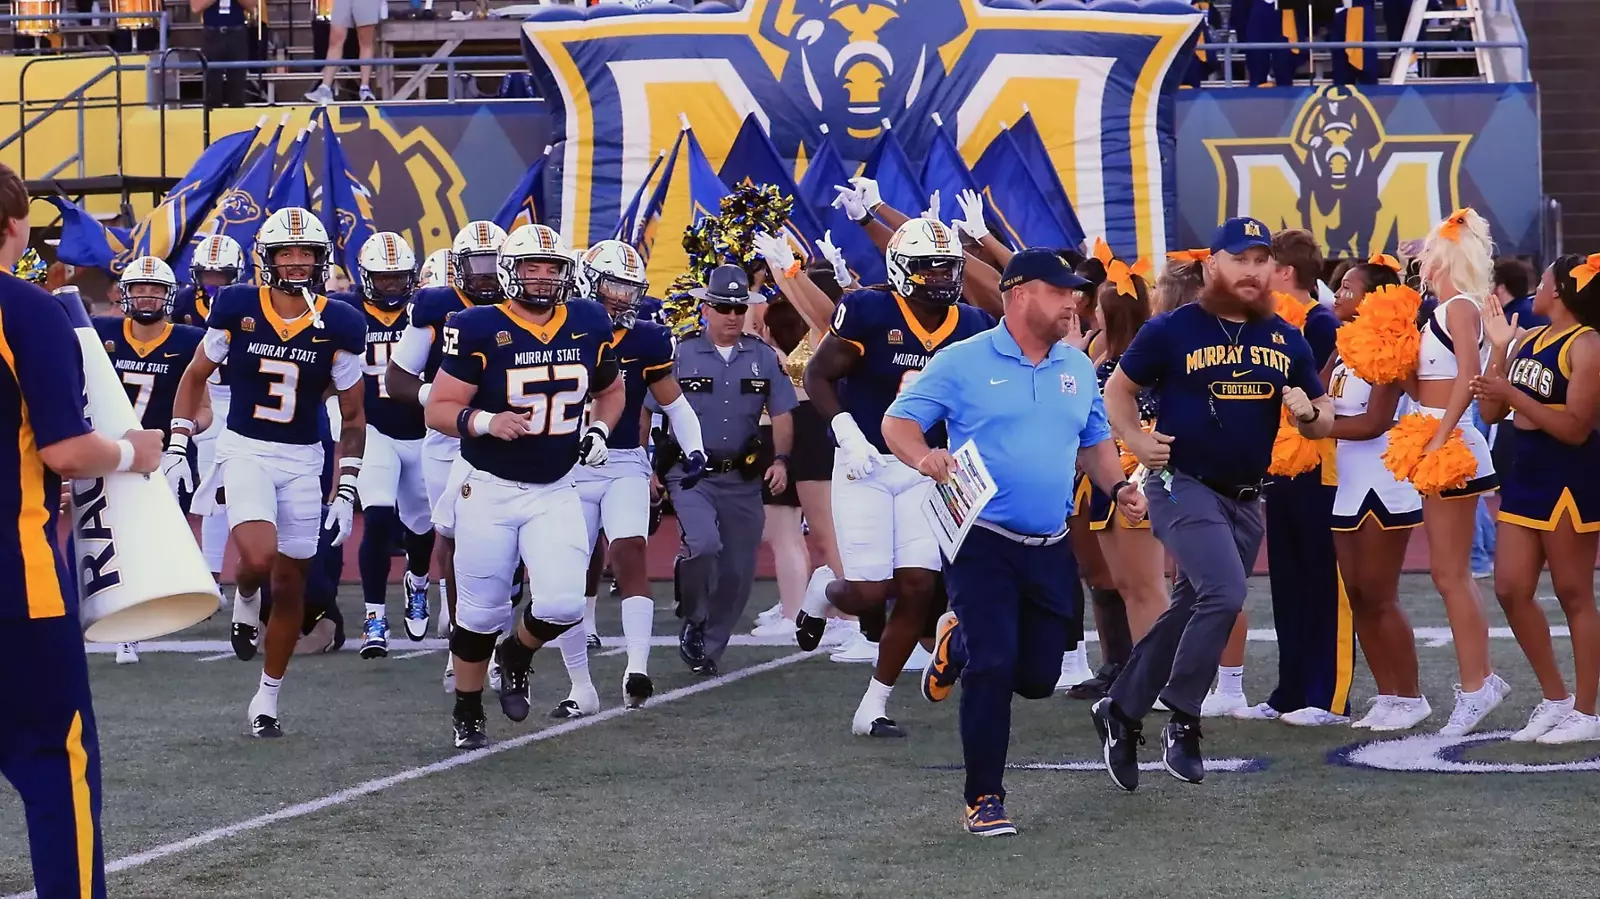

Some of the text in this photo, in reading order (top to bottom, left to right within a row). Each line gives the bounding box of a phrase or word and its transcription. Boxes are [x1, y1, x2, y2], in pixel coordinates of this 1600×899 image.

[367, 331, 392, 342] URRAY
[442, 326, 460, 355] 52
[247, 342, 317, 363] MURRAY STATE
[515, 348, 581, 365] MURRAY STATE
[892, 352, 931, 367] MURRAY
[1186, 345, 1291, 379] MURRAY STATE
[115, 359, 169, 374] MURRAY STATE
[1508, 358, 1554, 398] CERS
[123, 371, 155, 422] 7
[253, 358, 300, 423] 3
[506, 363, 589, 435] 52
[1222, 384, 1263, 395] FOOTBALL
